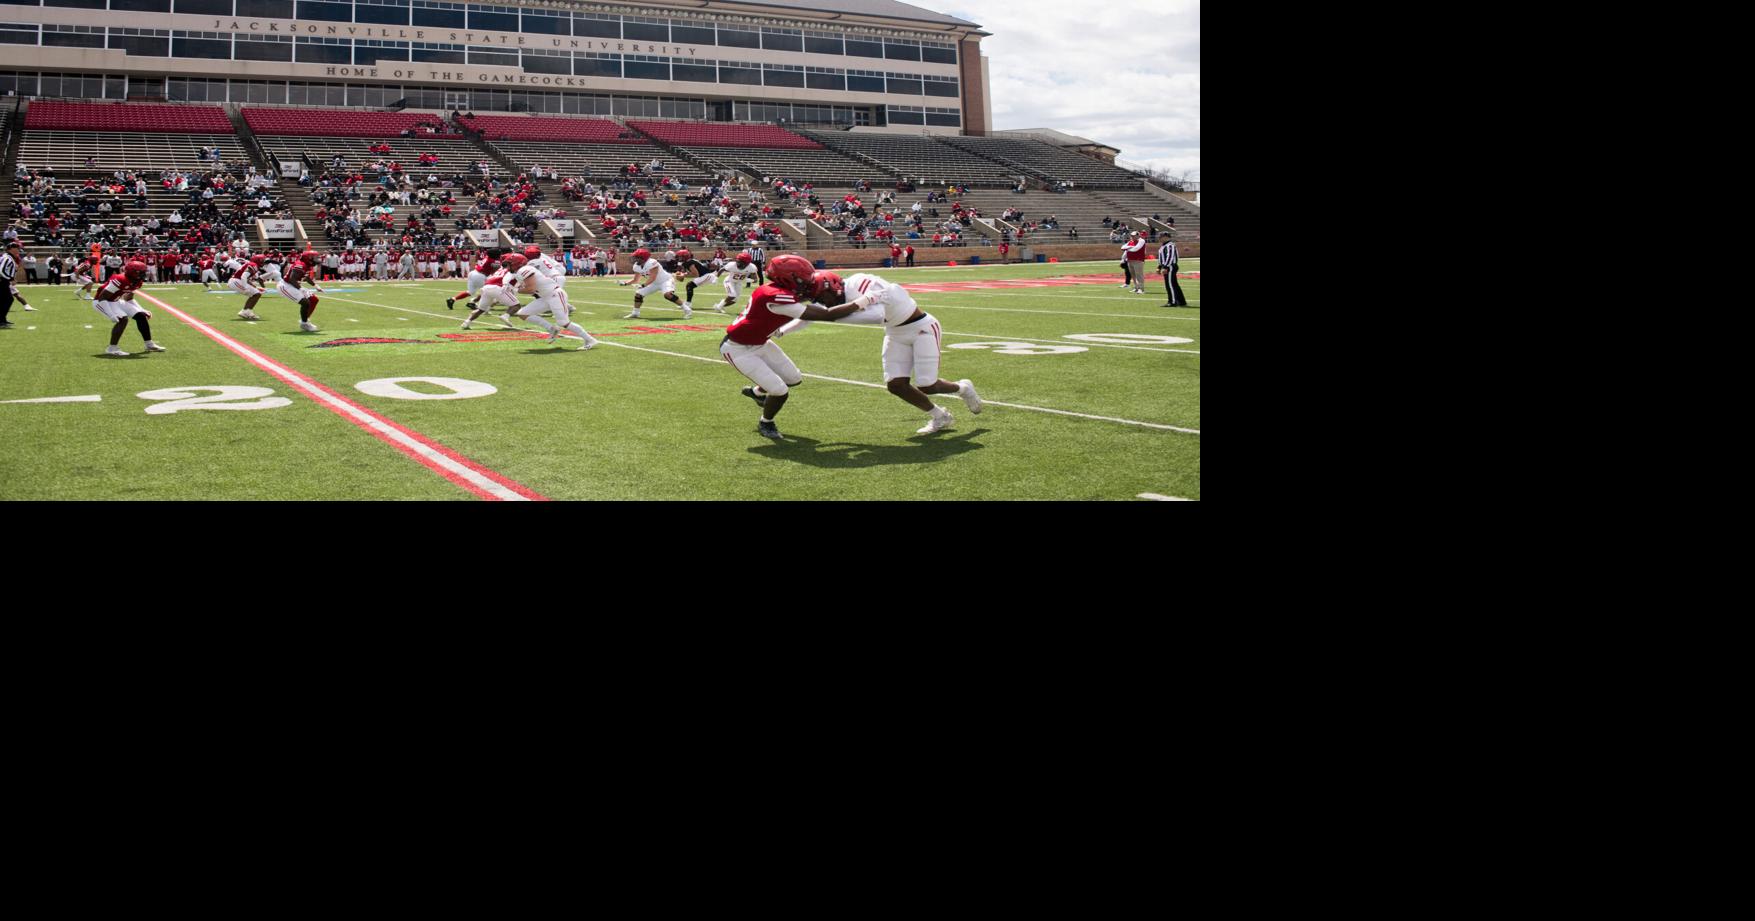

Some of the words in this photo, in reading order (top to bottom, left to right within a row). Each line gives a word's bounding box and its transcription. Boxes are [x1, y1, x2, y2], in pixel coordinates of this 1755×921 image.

[214, 20, 425, 39] JACKSONVILLE
[450, 32, 525, 45] STATE
[552, 38, 697, 56] UNIVERSITY
[326, 67, 378, 77] HOME
[394, 70, 415, 79] OF
[430, 71, 464, 81] THE
[479, 73, 586, 86] GAMECOCKS
